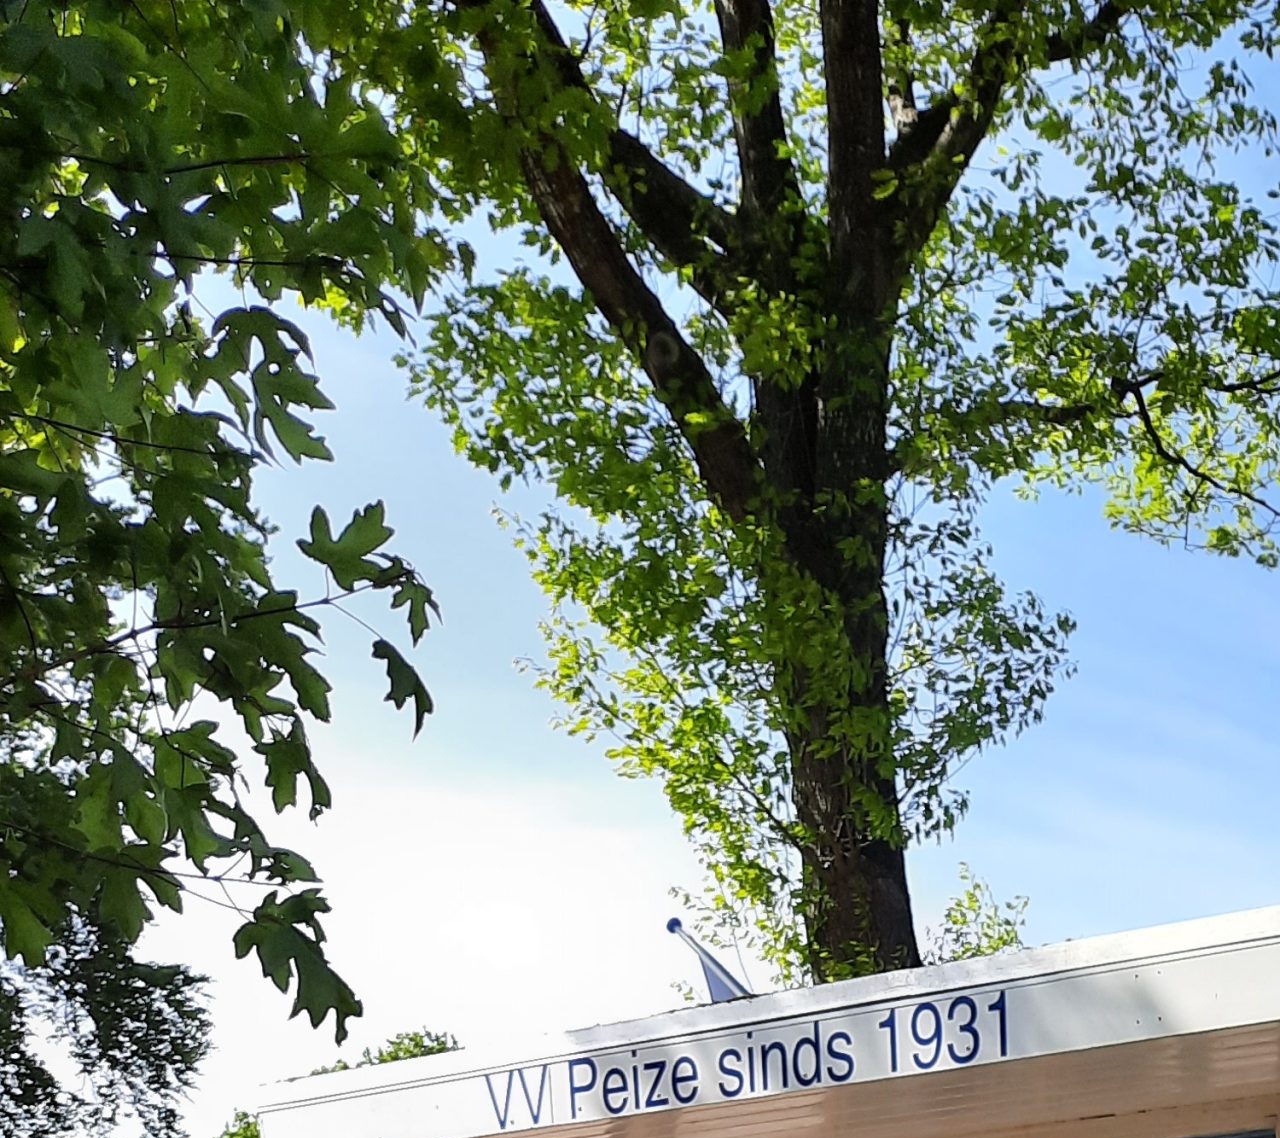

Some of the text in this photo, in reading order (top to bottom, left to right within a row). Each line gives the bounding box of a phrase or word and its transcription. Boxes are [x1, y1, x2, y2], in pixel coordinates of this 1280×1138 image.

[485, 990, 1010, 1130] VV Peize sinds 1931
